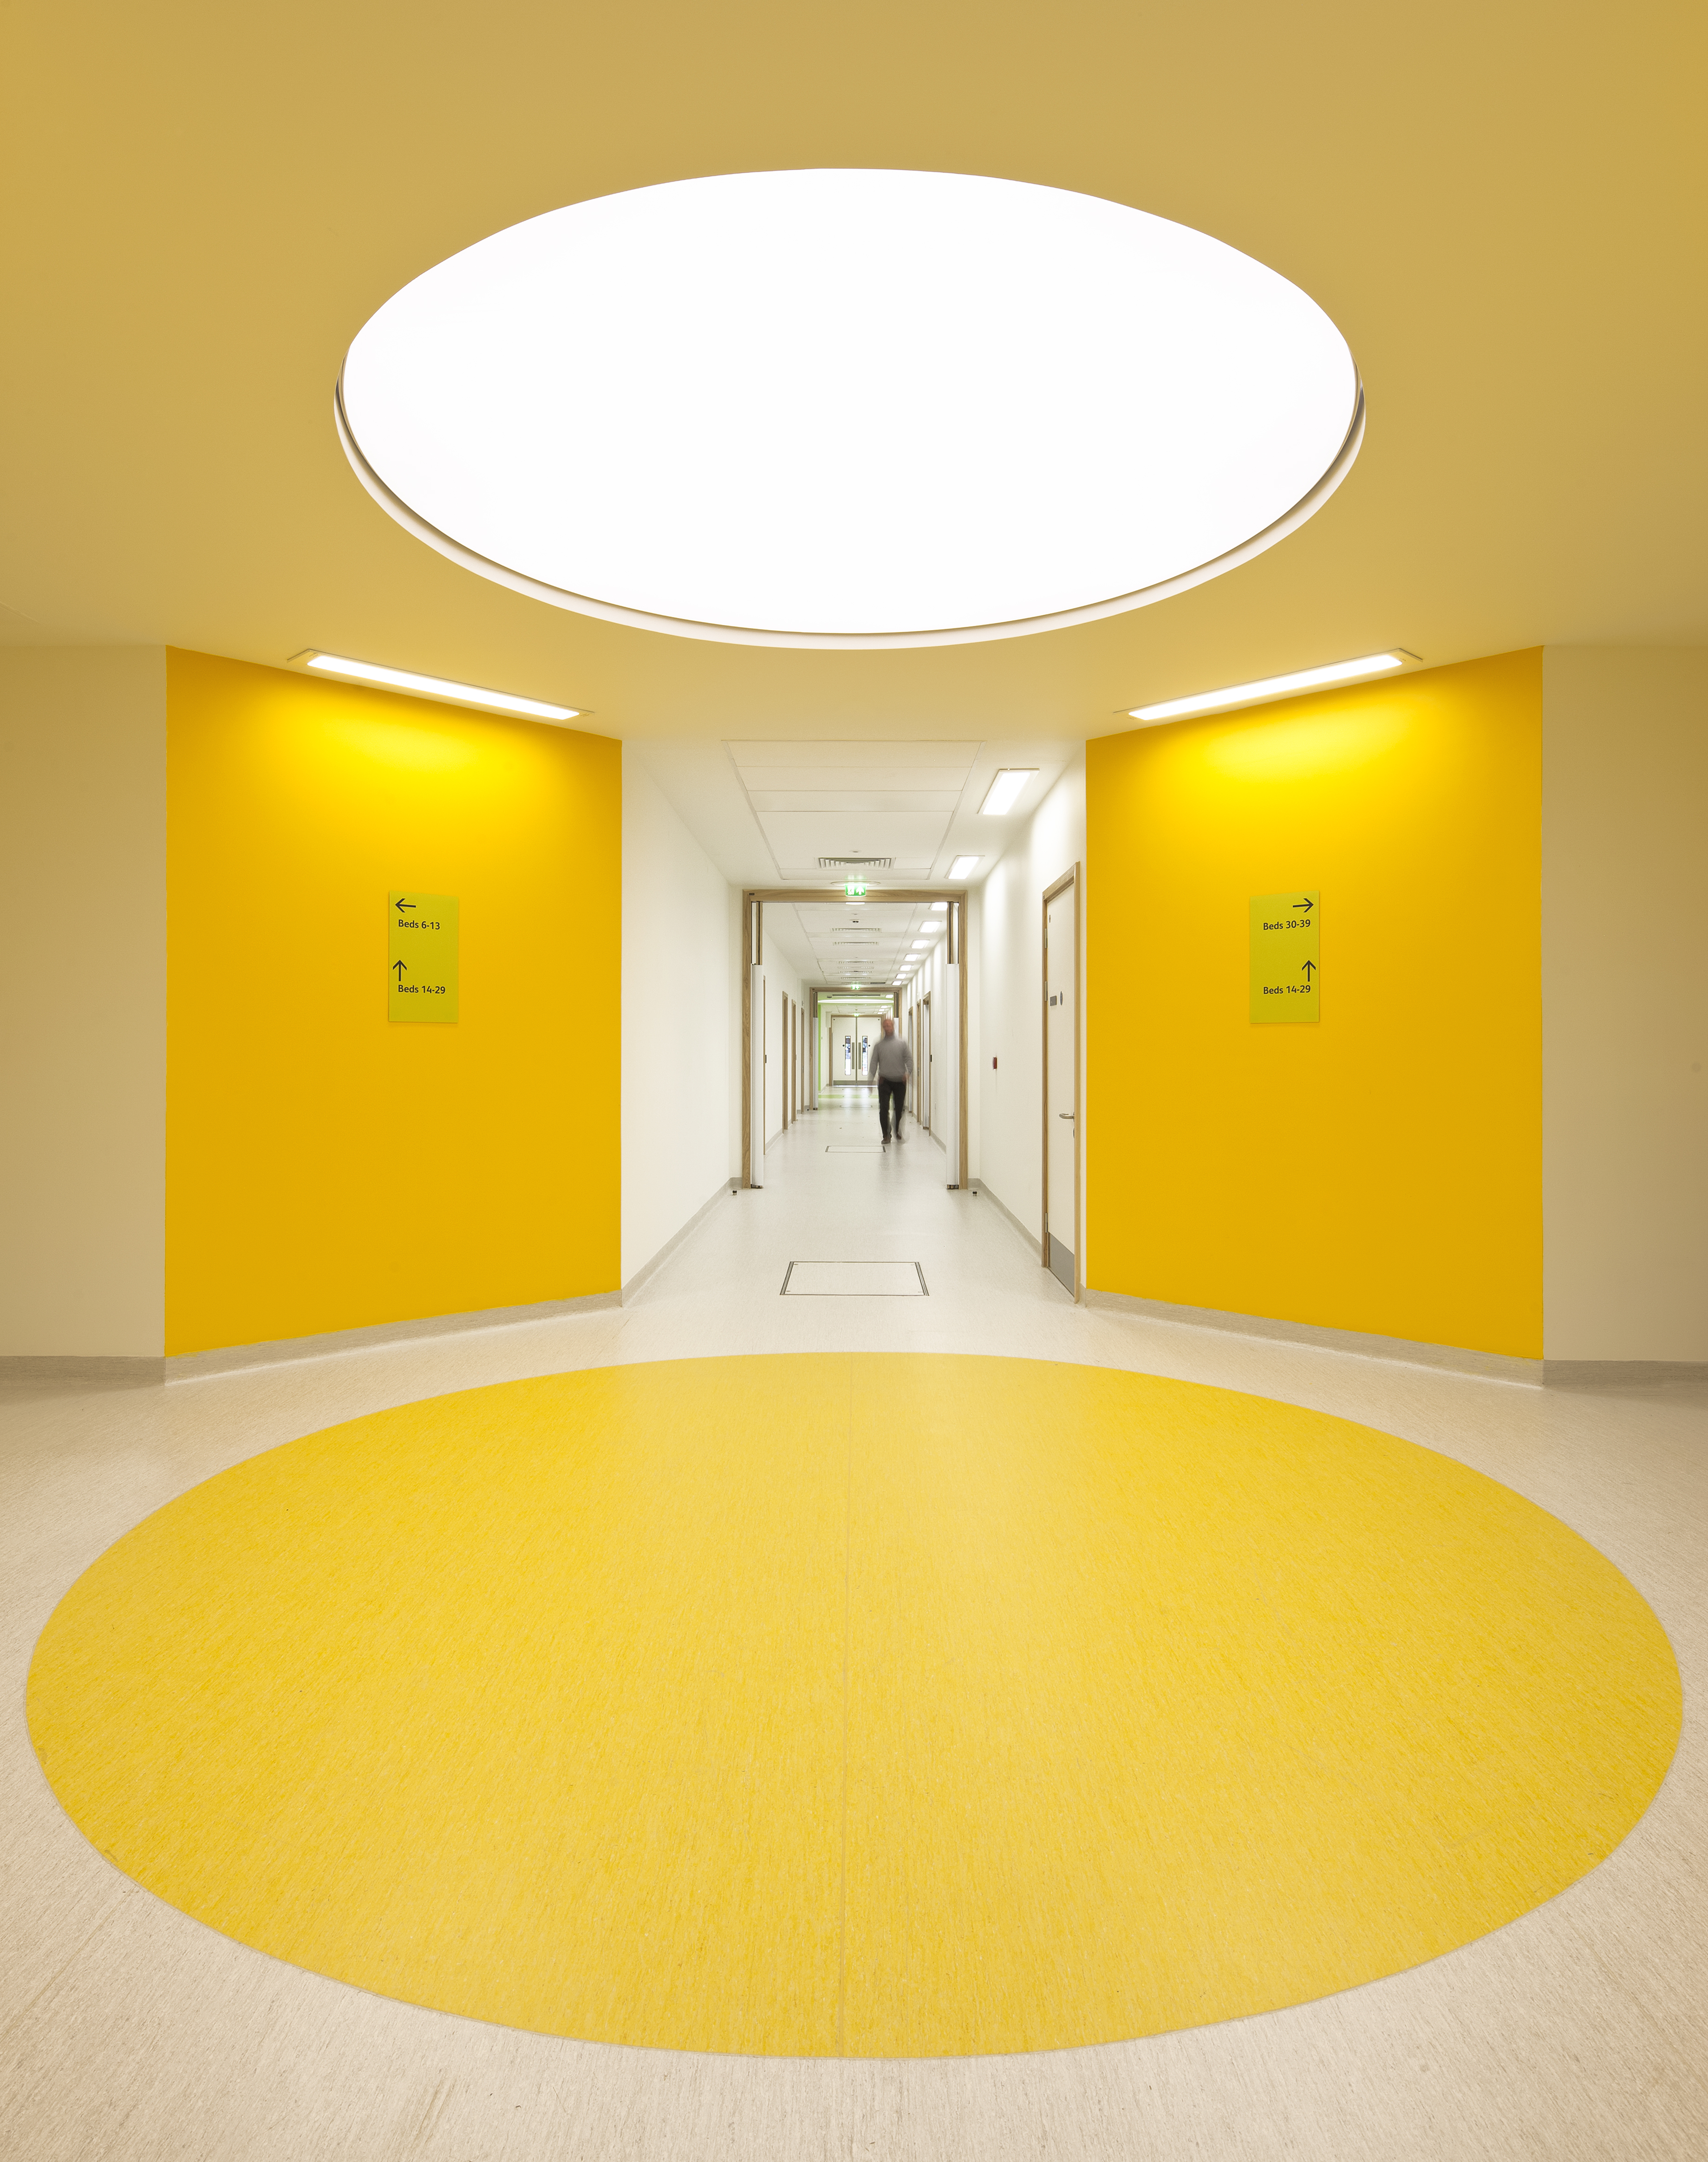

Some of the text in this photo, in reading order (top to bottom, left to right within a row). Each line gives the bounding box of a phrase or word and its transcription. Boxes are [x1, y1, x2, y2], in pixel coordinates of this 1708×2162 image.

[398, 919, 440, 930] Beds 6-13
[1263, 919, 1310, 931] Beds 30-39
[398, 984, 445, 994] Beds 14-29
[1263, 985, 1311, 995] Beds 14-29
